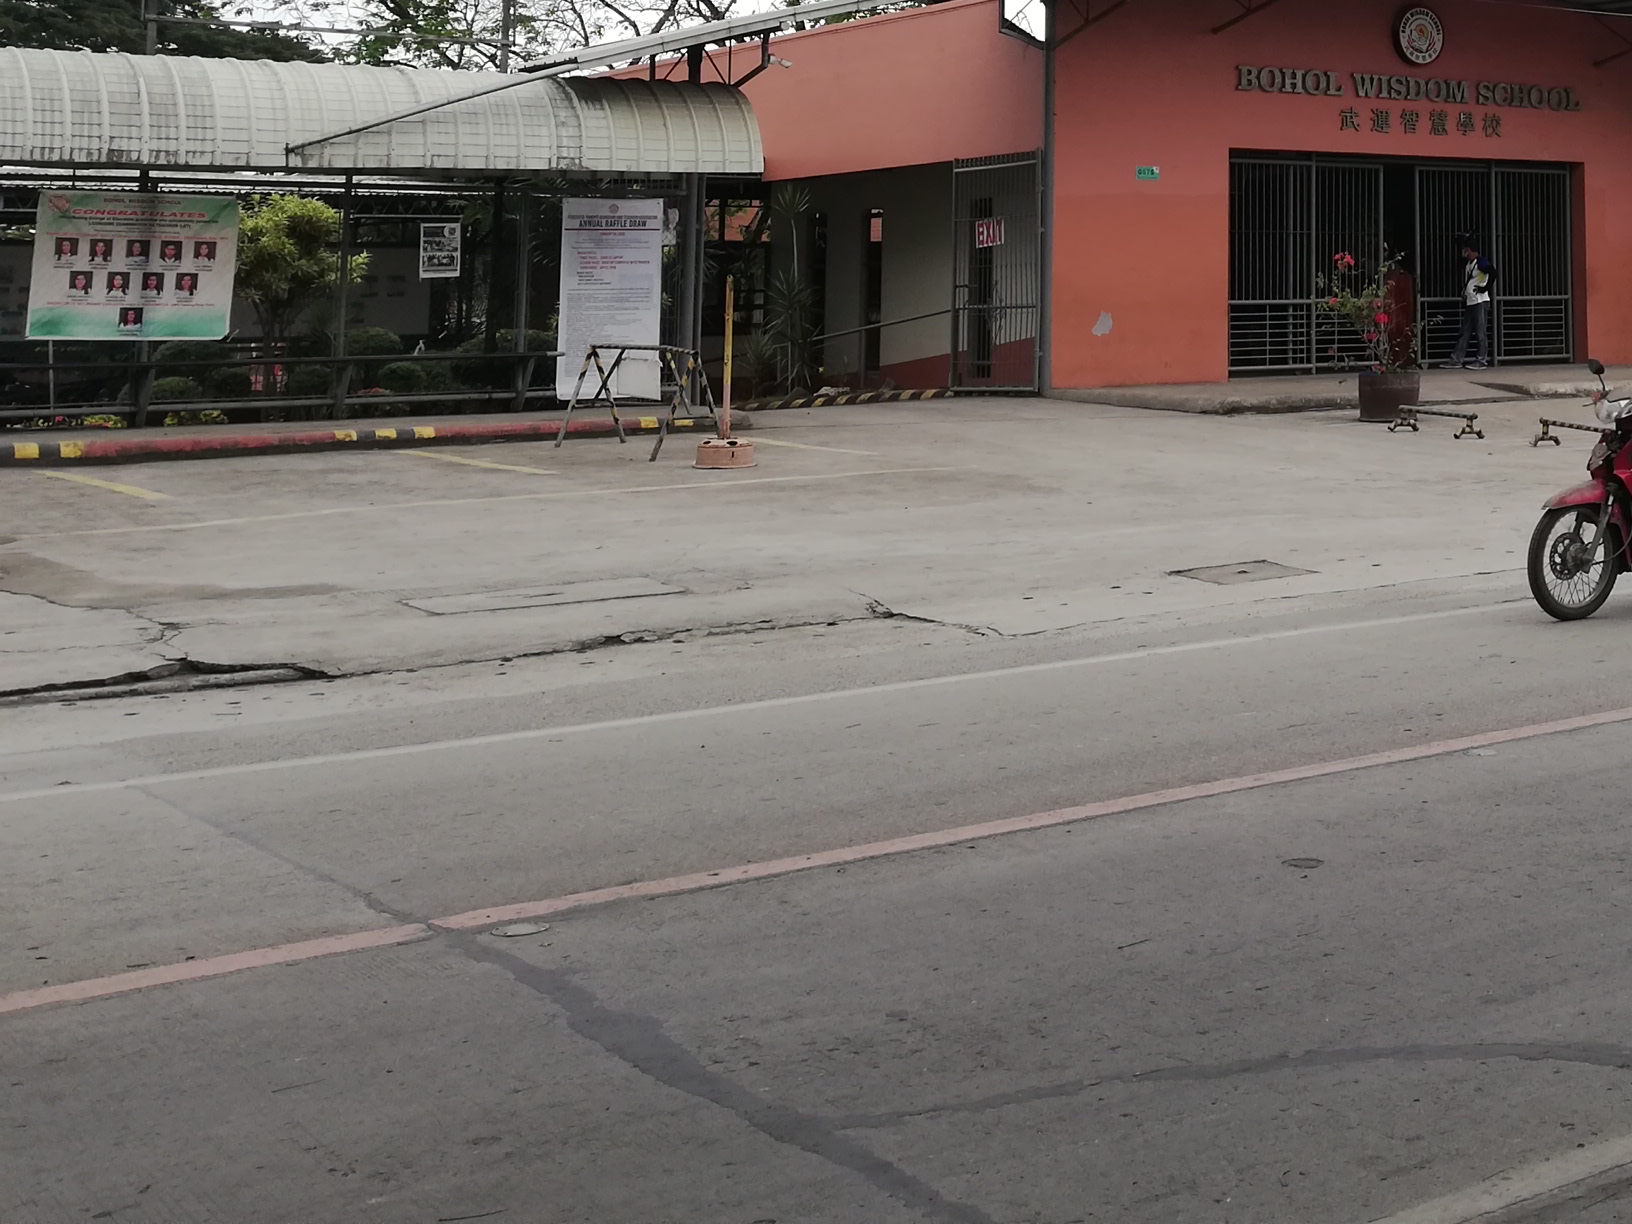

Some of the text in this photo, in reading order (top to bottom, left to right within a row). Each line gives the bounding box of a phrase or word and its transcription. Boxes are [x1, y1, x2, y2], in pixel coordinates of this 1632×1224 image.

[1236, 65, 1584, 112] BOHOL WISDOM SCHOOL
[72, 208, 208, 219] CONGRATULATES
[578, 219, 648, 228] ANNUAL RAFFLE DRAW
[978, 218, 1003, 248] EXIT
